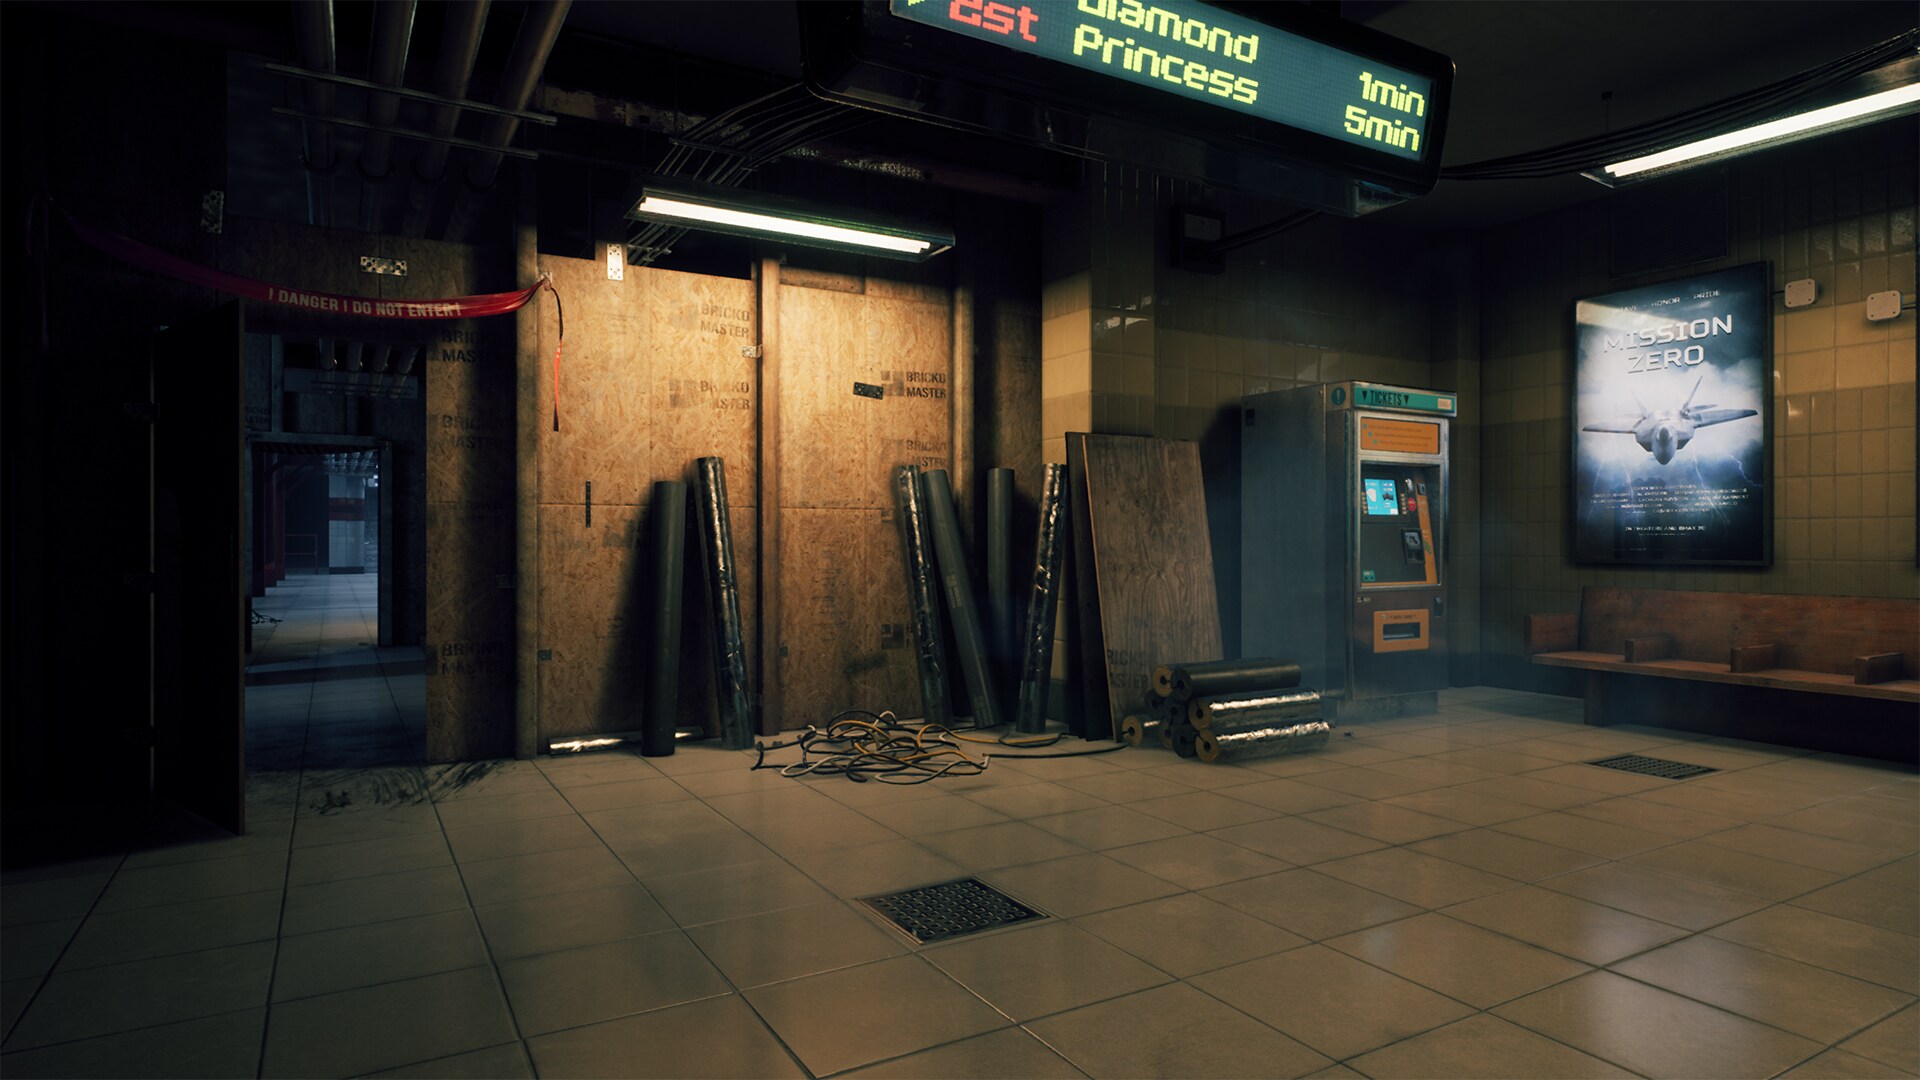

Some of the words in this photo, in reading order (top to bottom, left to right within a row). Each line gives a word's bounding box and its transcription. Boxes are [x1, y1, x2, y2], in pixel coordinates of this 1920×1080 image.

[1073, 23, 1259, 105] Princess
[1344, 104, 1420, 152] 5min
[1359, 71, 1425, 117] 1min
[278, 289, 339, 312] DANGER
[352, 301, 372, 315] DO
[376, 302, 402, 317] NOT
[408, 303, 456, 318] ENTER
[1603, 314, 1733, 353] MISSION
[1627, 344, 1705, 375] ZERO
[906, 370, 946, 384] BRICKO
[906, 387, 947, 399] MASTER
[1370, 390, 1402, 406] TICKETS
